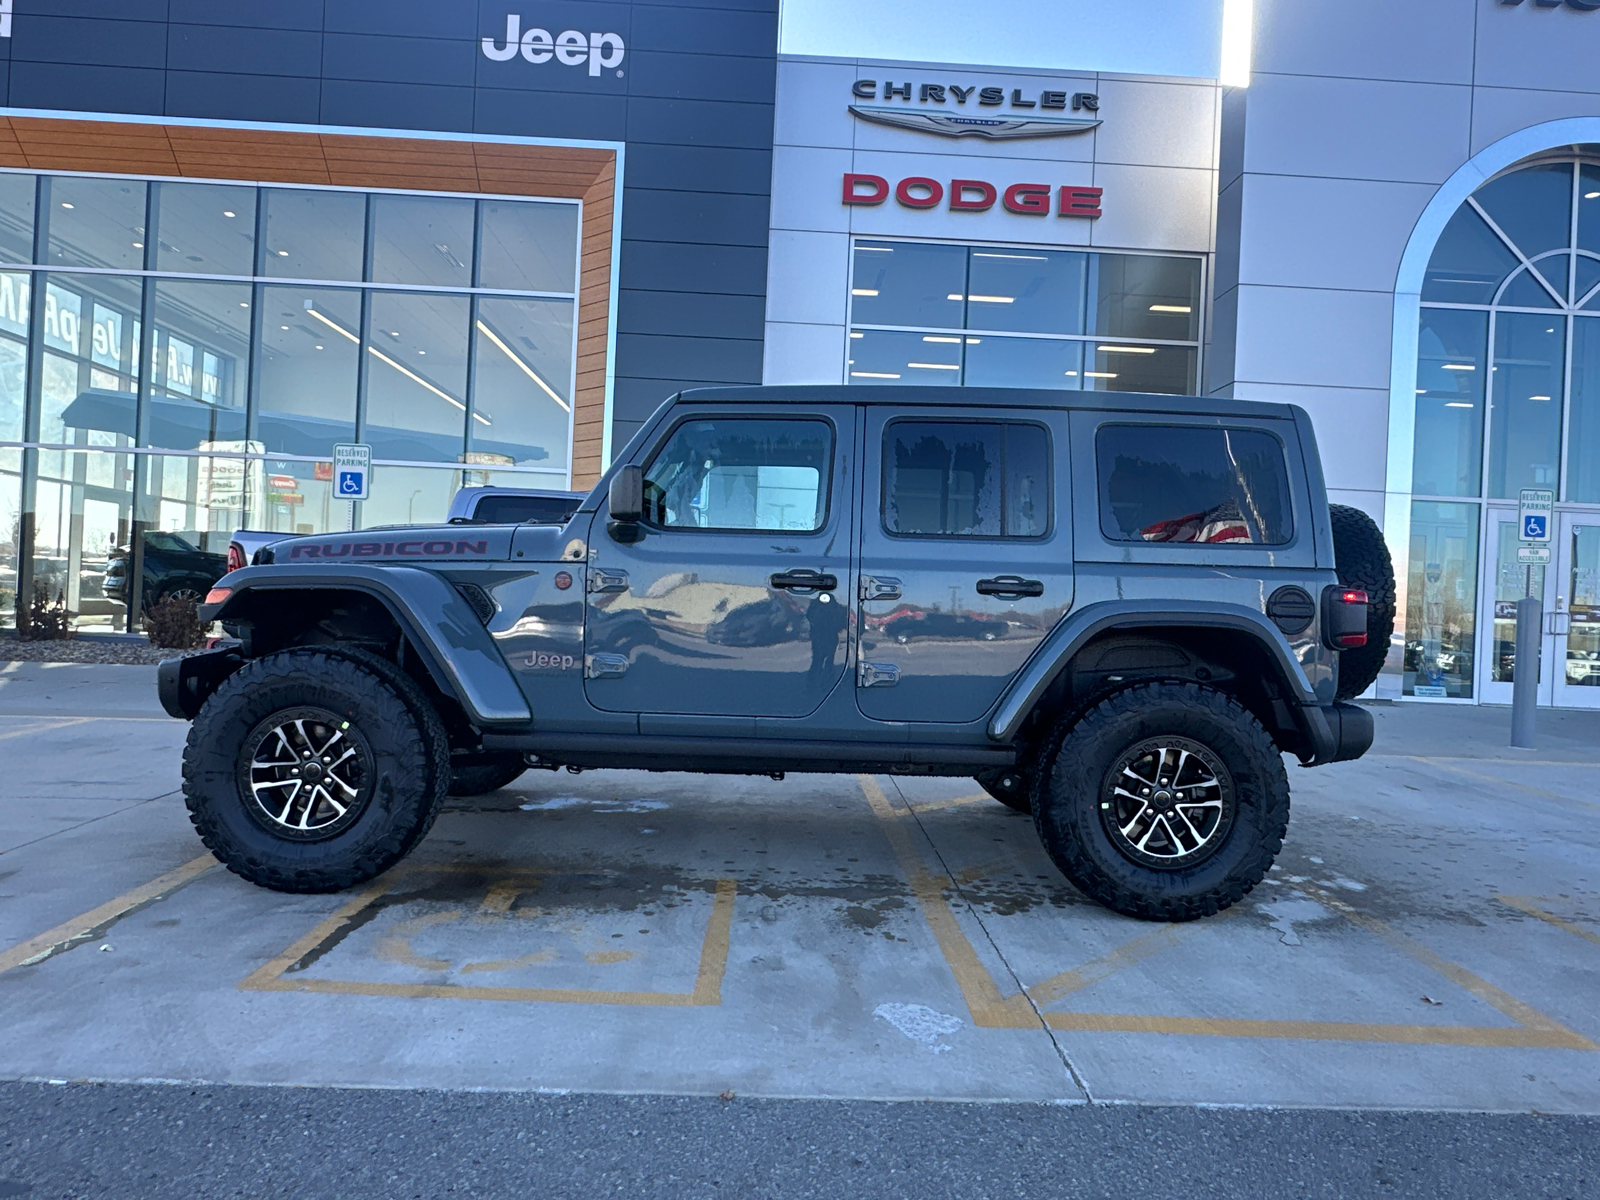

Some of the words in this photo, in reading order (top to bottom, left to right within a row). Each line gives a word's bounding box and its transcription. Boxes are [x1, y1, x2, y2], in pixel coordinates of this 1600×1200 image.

[481, 14, 625, 77] Jeep
[852, 79, 1101, 111] CHRYSLER
[842, 173, 1104, 219] DODGE
[336, 459, 368, 467] PARKING
[337, 449, 368, 458] RESERVED
[1521, 493, 1551, 502] RESERVED
[1521, 502, 1551, 511] PARKING
[290, 540, 489, 559] RUBICON
[523, 650, 575, 671] Jeep
